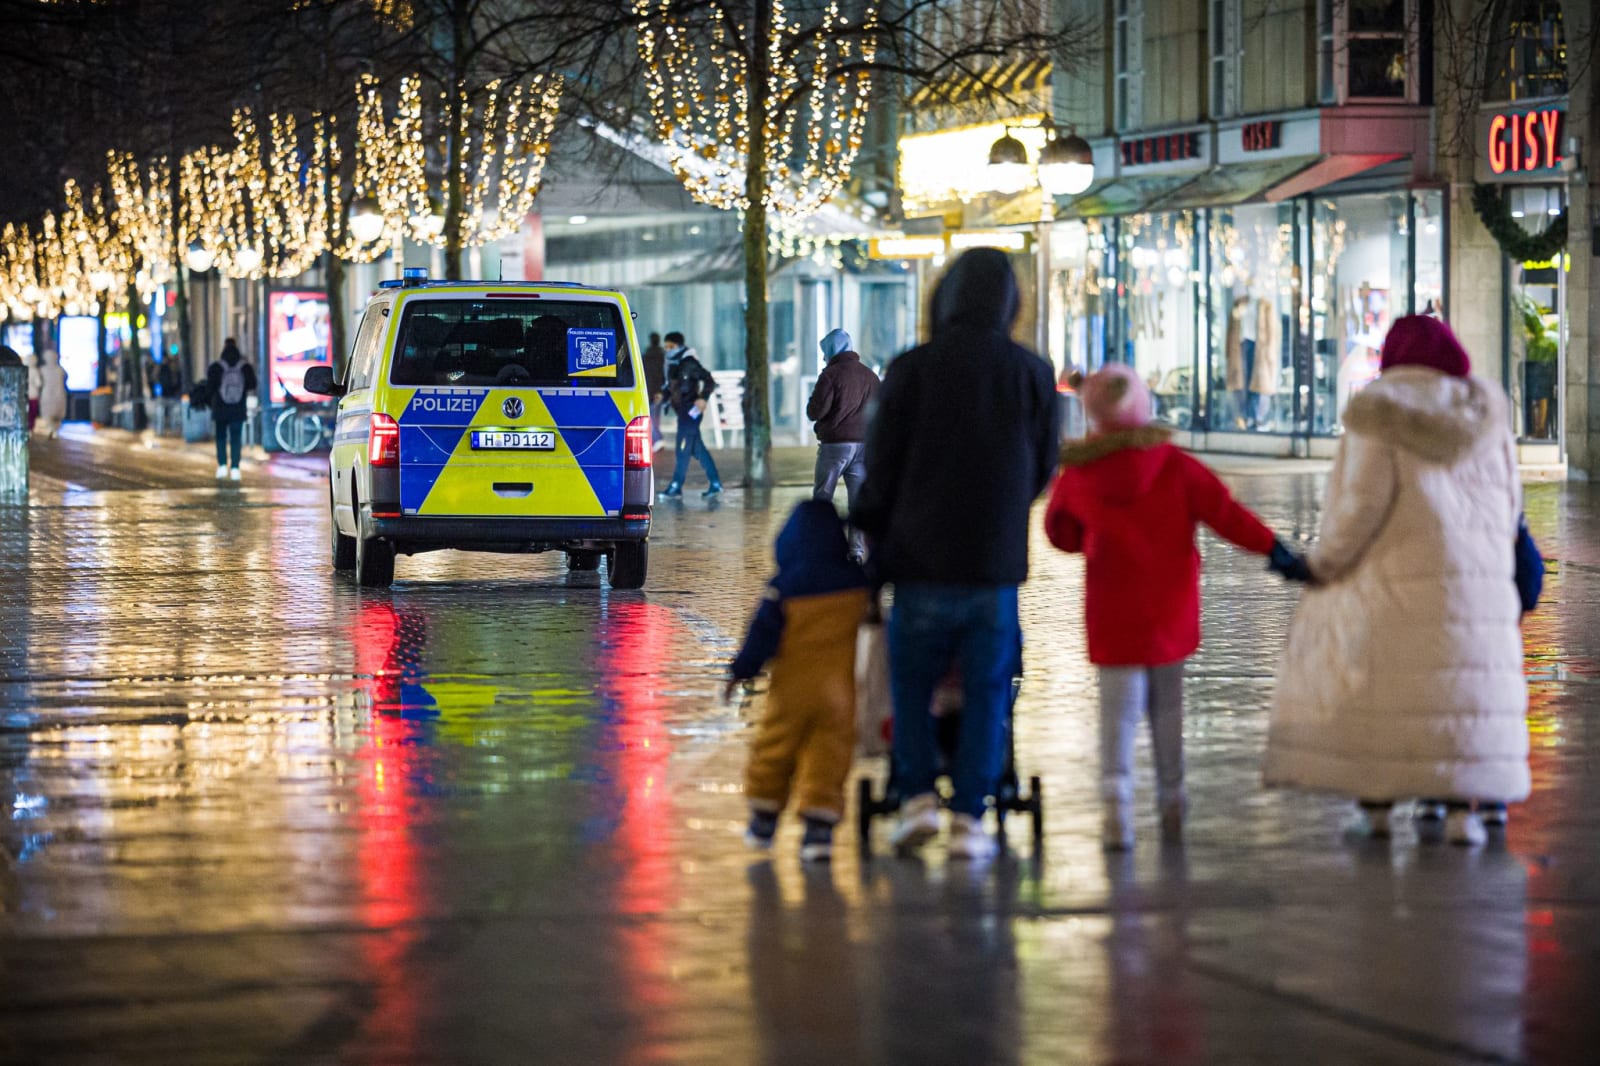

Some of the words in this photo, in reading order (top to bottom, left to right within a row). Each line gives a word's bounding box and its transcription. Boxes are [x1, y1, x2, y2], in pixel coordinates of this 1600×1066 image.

[1242, 120, 1273, 152] GISY
[1488, 109, 1559, 174] GISY
[412, 398, 477, 412] POLIZEI
[484, 434, 494, 447] H
